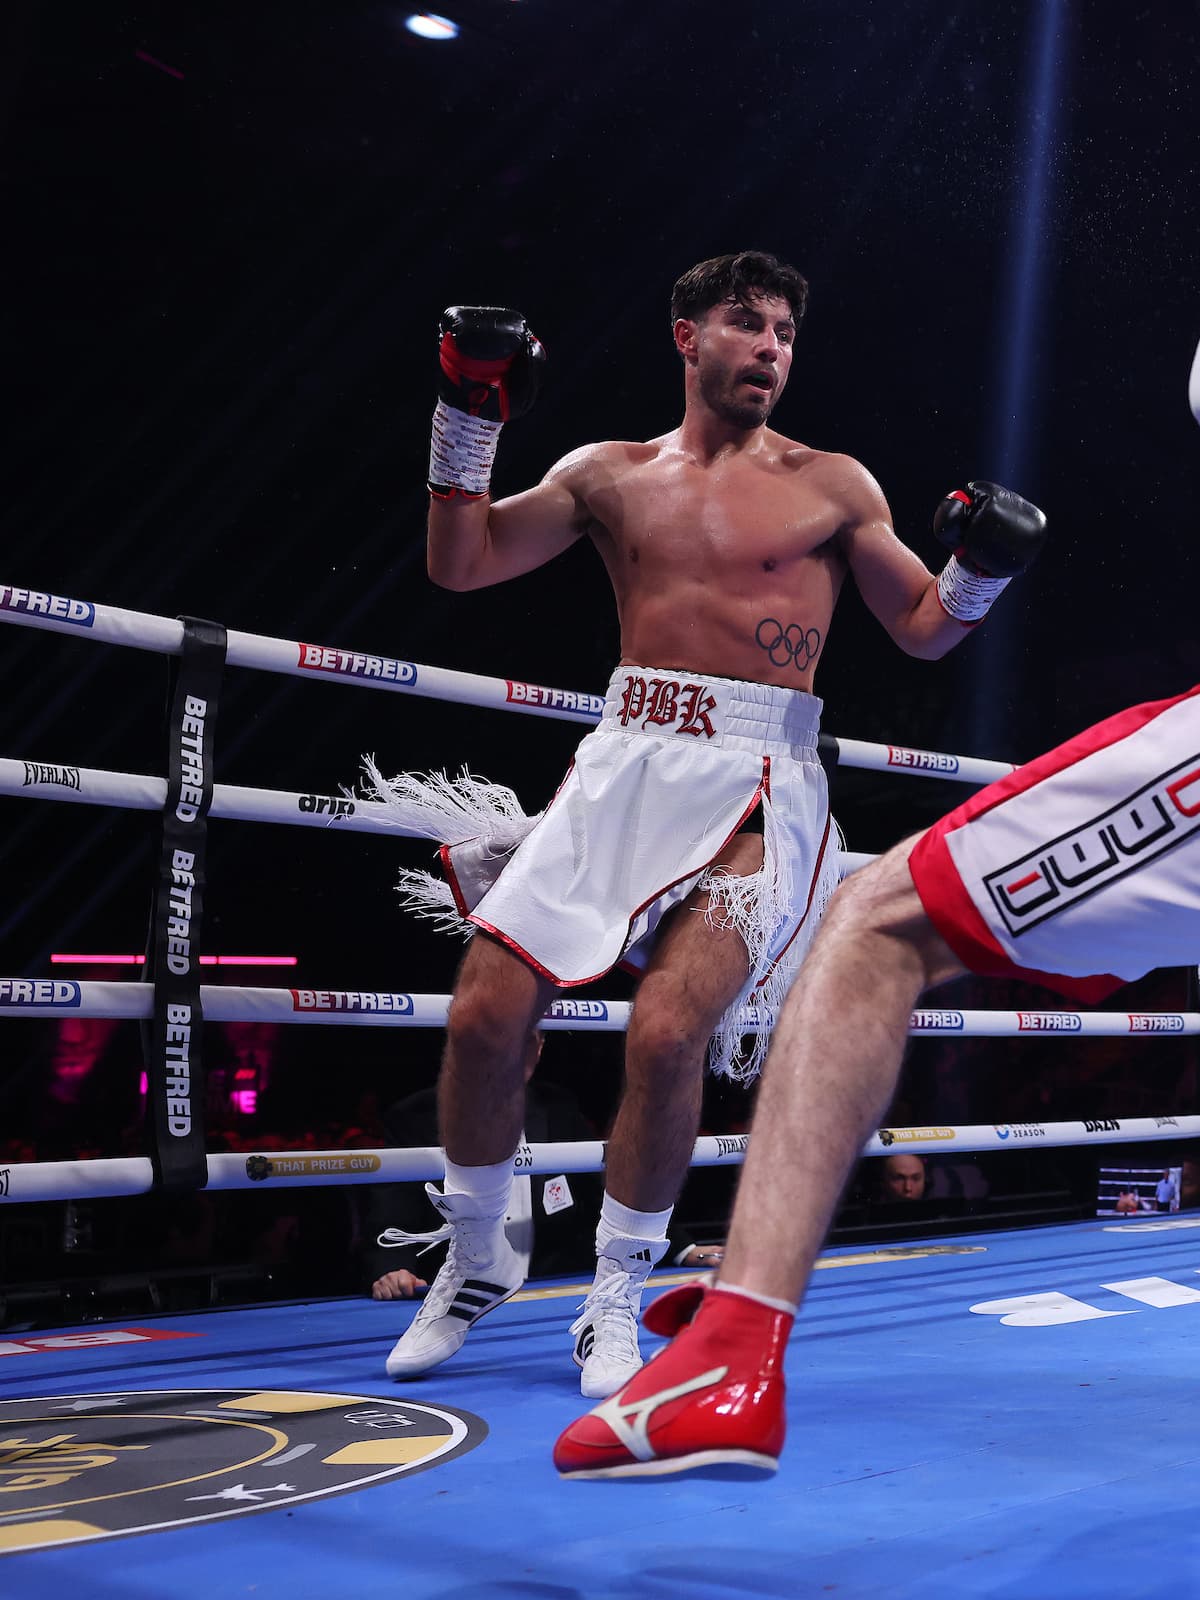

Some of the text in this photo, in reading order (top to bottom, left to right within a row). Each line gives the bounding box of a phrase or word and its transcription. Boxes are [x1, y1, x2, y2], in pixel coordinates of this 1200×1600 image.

[303, 646, 414, 682] BETFRED
[511, 683, 604, 713] BETFRED
[175, 694, 207, 823] BETFRED
[892, 747, 957, 773] BETFRED
[23, 761, 82, 792] EVERLAST
[299, 795, 356, 821] drip
[165, 848, 196, 976] BETFRED
[298, 989, 411, 1013] BETFRED
[544, 1000, 605, 1018] FRED
[1022, 1013, 1080, 1030] BETFRED
[1133, 1015, 1183, 1031] BETFRED
[166, 1004, 192, 1137] BETFRED
[1013, 1128, 1046, 1138] SEASON
[276, 1158, 374, 1173] THAT PRIZE GUY
